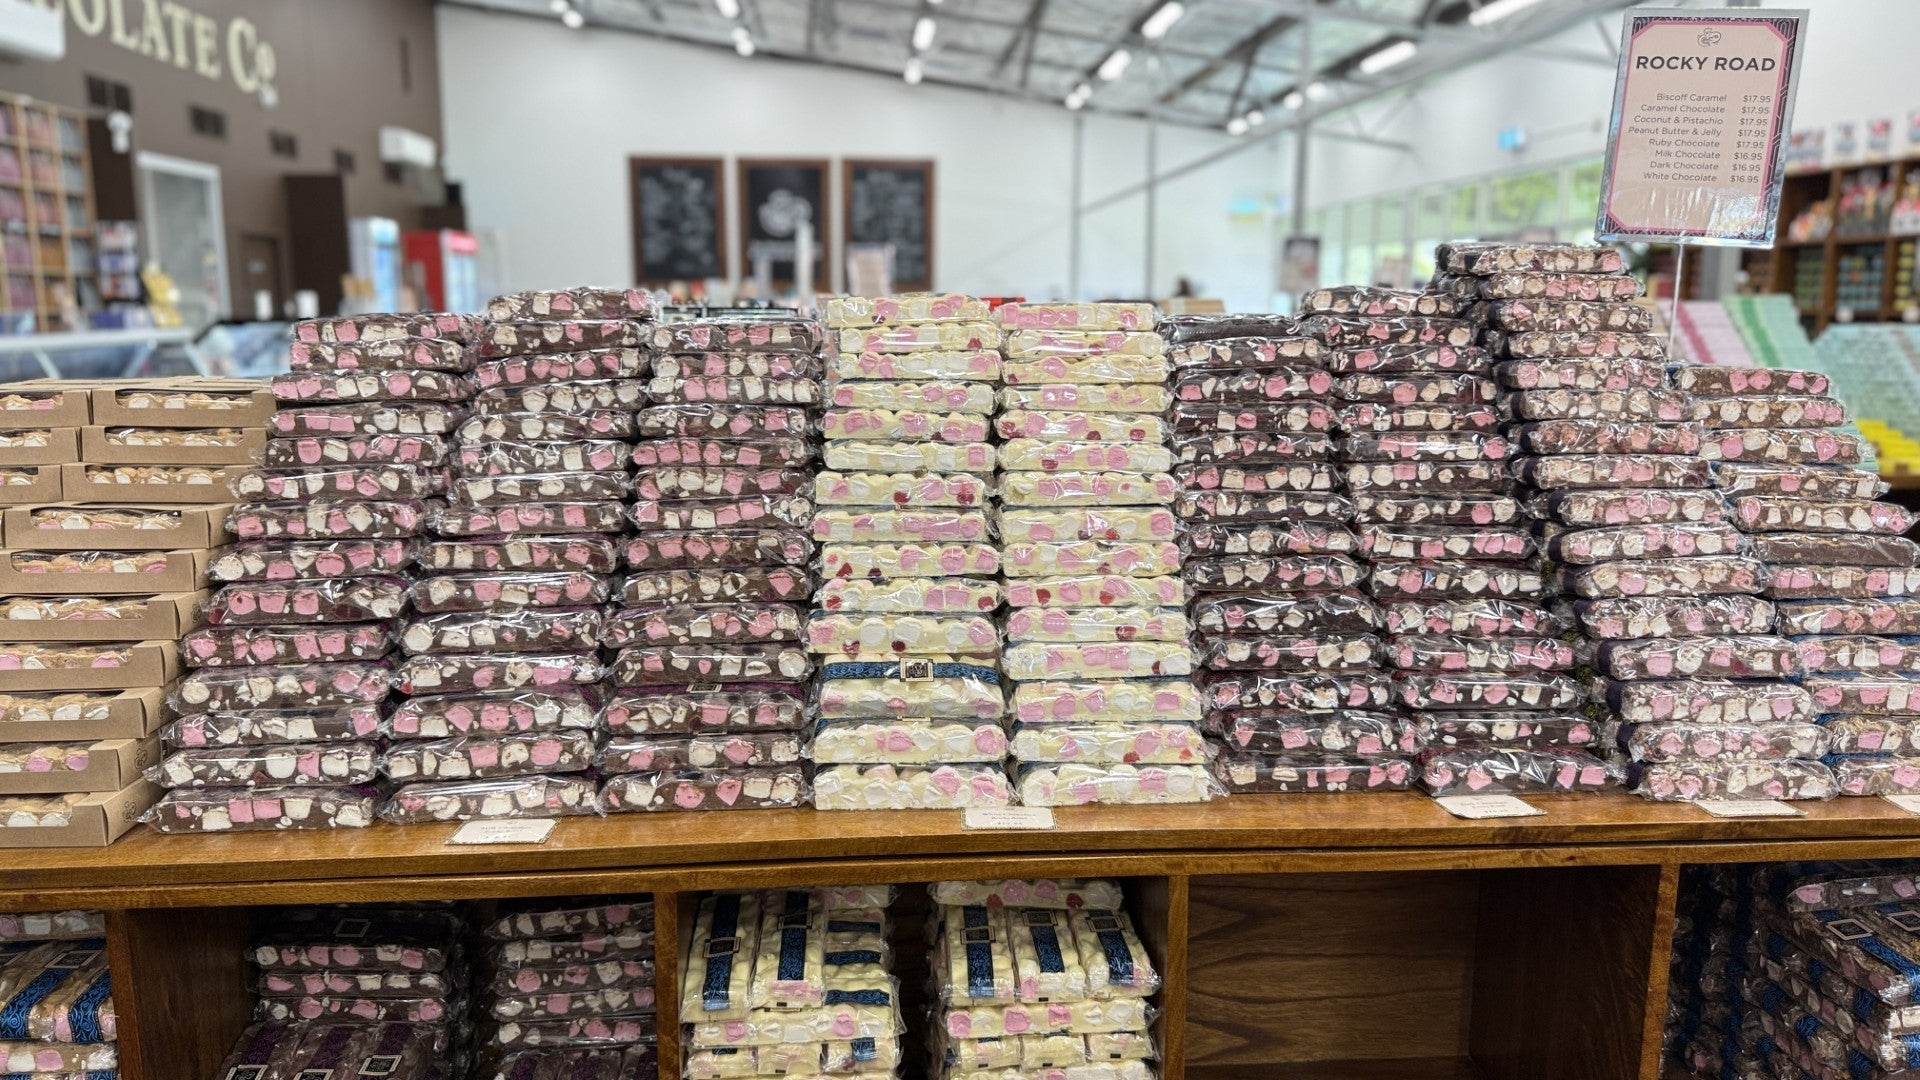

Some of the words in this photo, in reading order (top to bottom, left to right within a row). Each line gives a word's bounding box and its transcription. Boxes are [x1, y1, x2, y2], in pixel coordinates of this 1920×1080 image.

[33, 0, 222, 80] OLATE
[1636, 56, 1708, 70] ROCKY
[1714, 57, 1775, 71] ROAD
[1656, 93, 1688, 101] Biscoff
[1689, 94, 1727, 102] Caramel
[1743, 95, 1771, 103] $17.95
[1640, 104, 1677, 112] Caramel
[1679, 104, 1725, 113] Chocolate
[1741, 106, 1770, 114] $17.95
[1633, 115, 1671, 123] Coconut
[1674, 116, 1681, 124] &
[1682, 116, 1724, 125] Pistachio
[1739, 118, 1768, 126] $17.95
[1628, 126, 1659, 134] Peanut
[1661, 127, 1689, 135] Butter
[1701, 128, 1721, 137] Jelly
[1737, 129, 1766, 137] $17.95
[1648, 138, 1672, 147] Ruby
[1674, 139, 1720, 148] Chocolate
[1736, 141, 1765, 149] $17.95
[1675, 151, 1720, 159] Chocolate
[1734, 152, 1763, 160] $16.95
[1650, 161, 1671, 169] Dark
[1673, 162, 1719, 170] Chocolate
[1732, 163, 1761, 171] $16.95
[1643, 172, 1669, 180] White
[1671, 172, 1717, 181] Chocolate
[1730, 174, 1759, 183] $16.95
